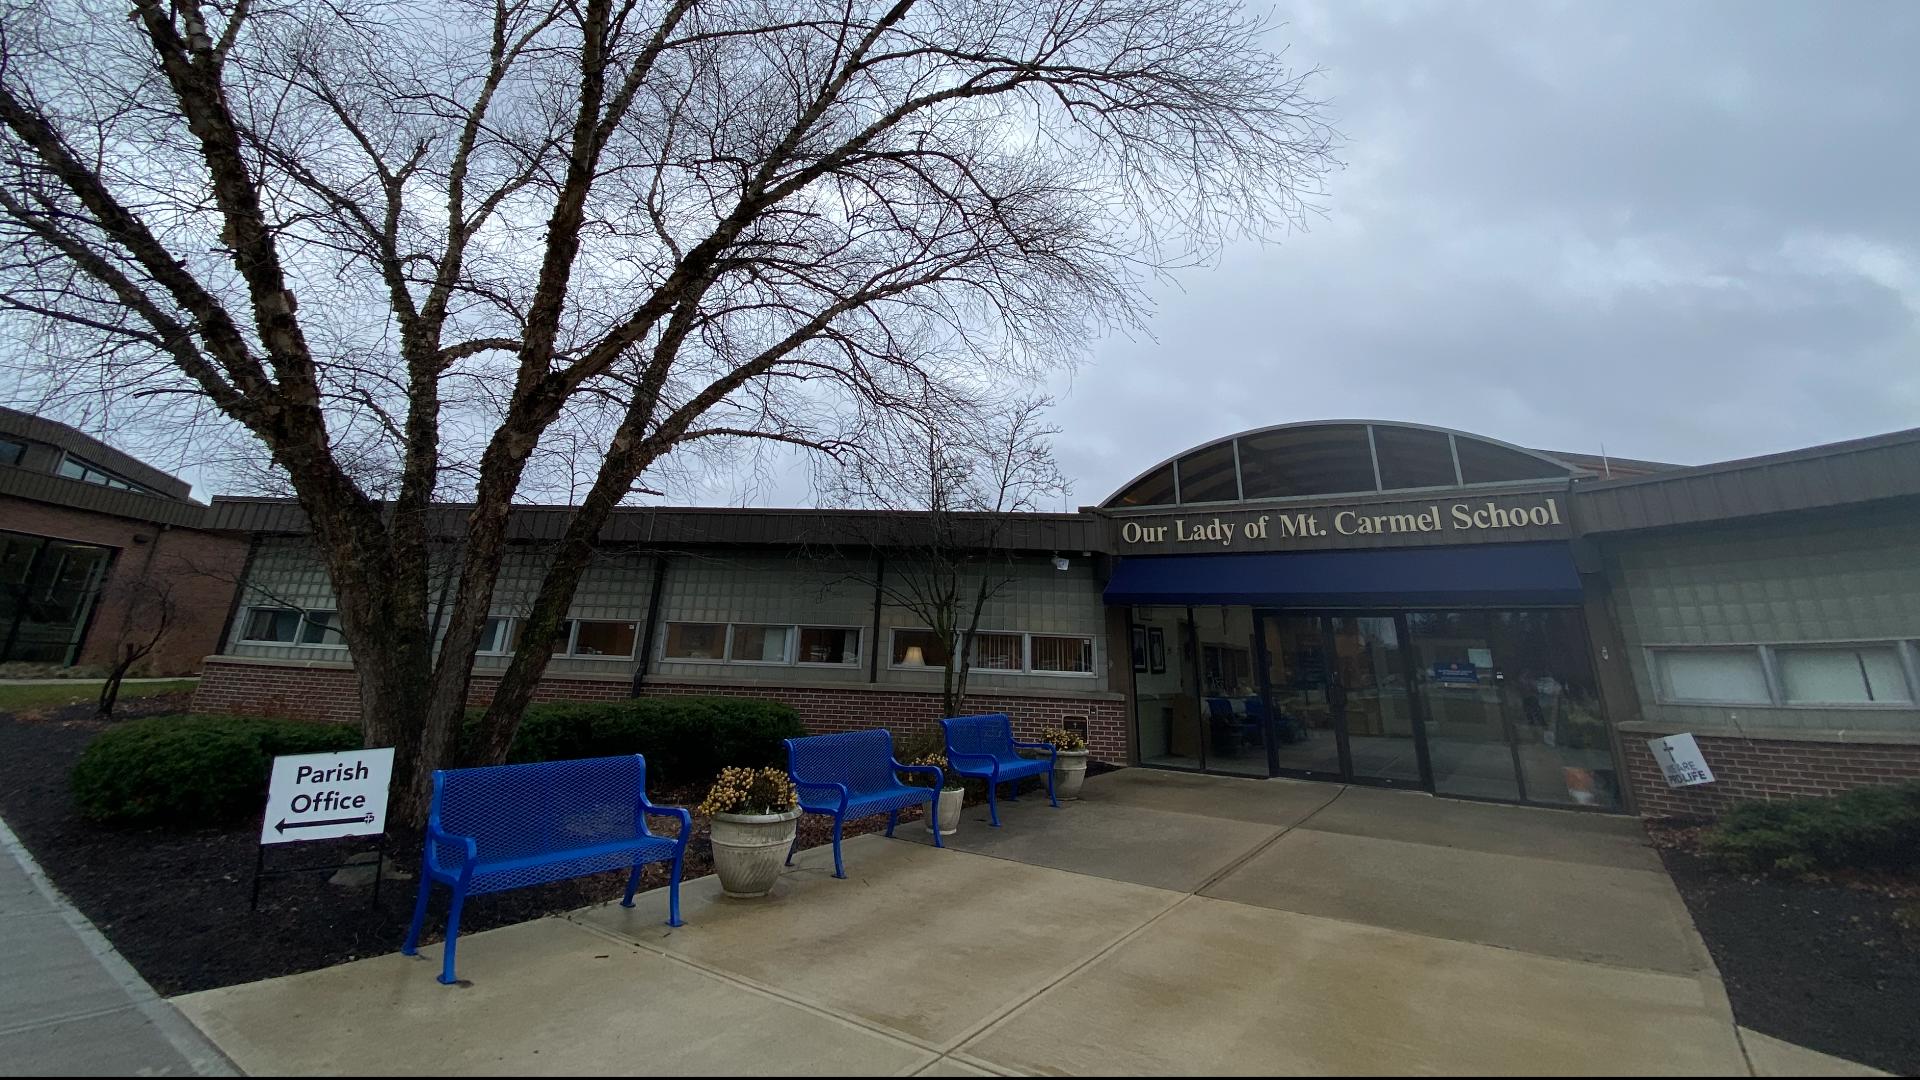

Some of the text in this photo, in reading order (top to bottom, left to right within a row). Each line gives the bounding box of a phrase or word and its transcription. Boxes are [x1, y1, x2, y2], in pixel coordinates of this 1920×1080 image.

[1122, 498, 1562, 545] Our Lady of Mt. Carmel School
[296, 761, 368, 784] Parish
[291, 791, 366, 813] Office
